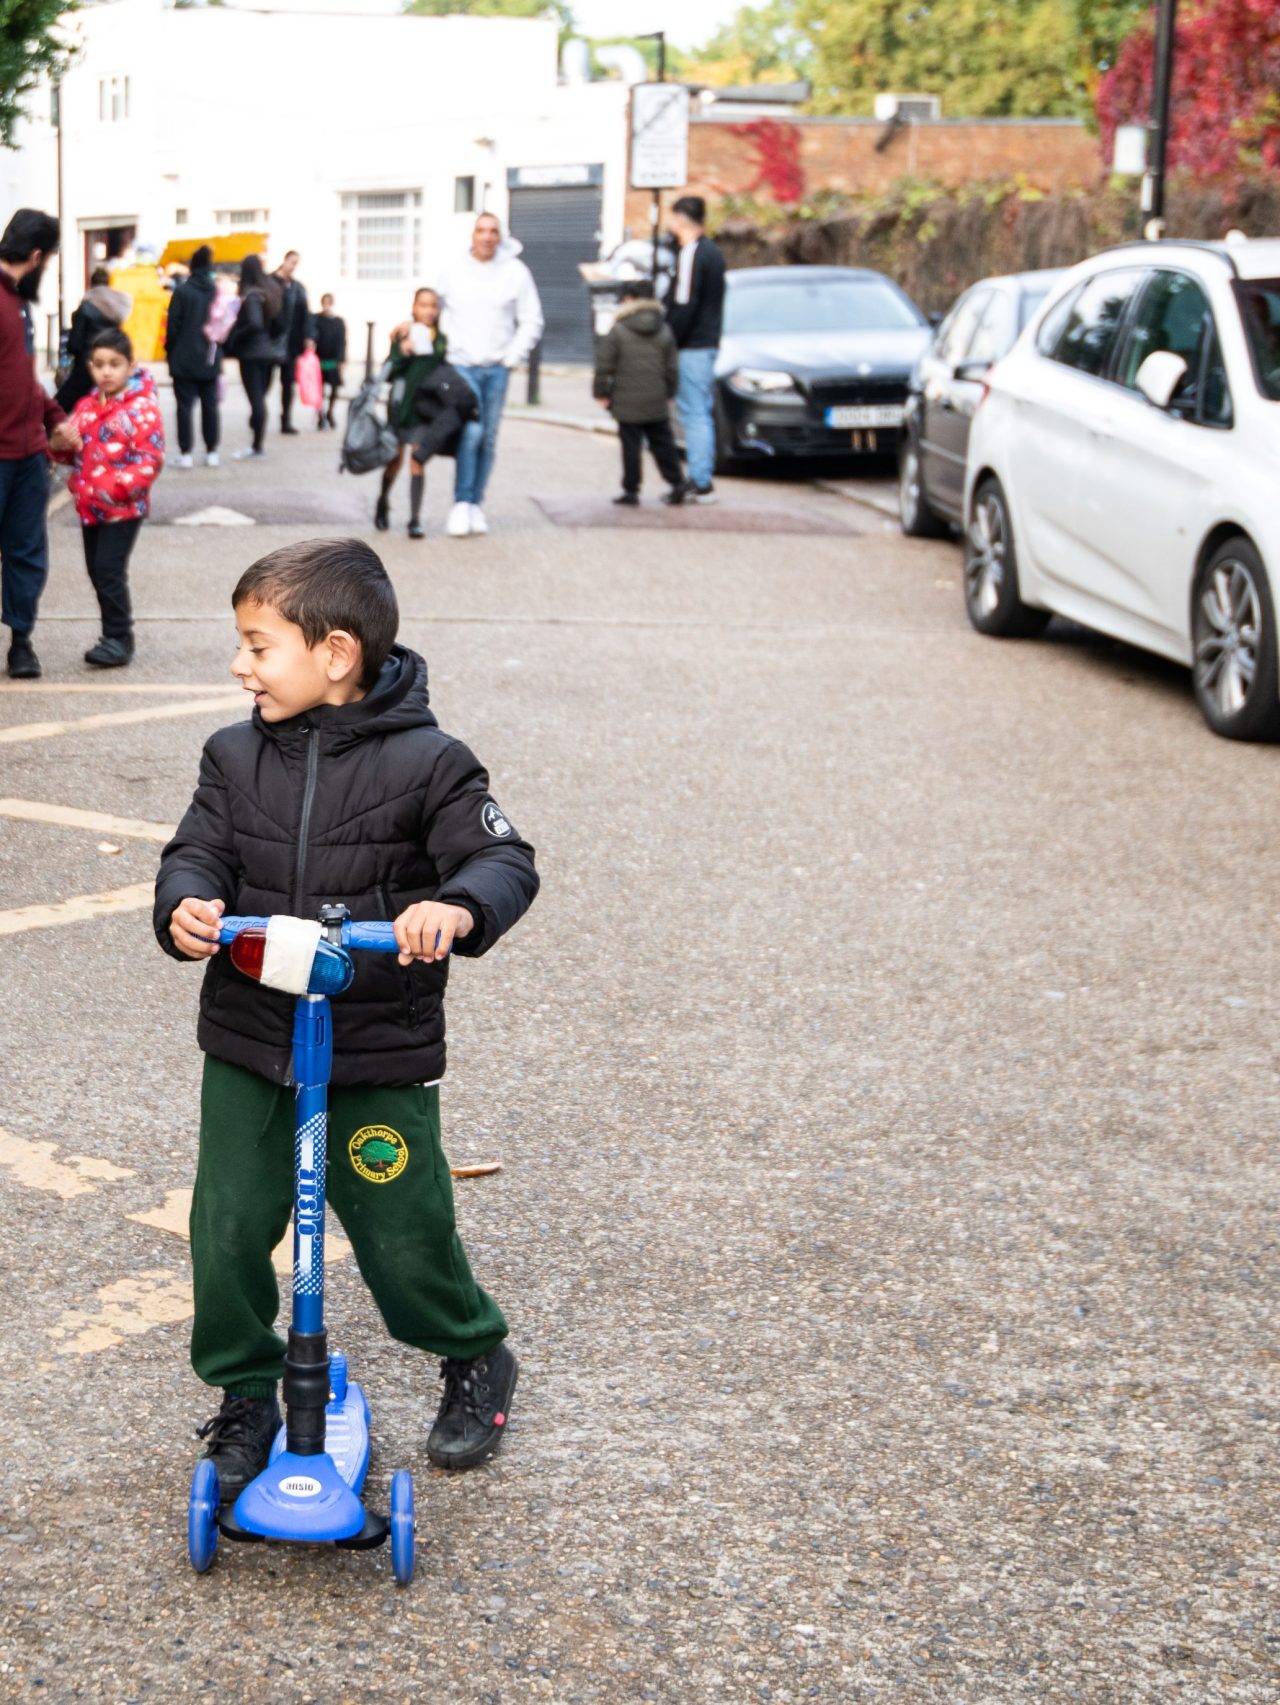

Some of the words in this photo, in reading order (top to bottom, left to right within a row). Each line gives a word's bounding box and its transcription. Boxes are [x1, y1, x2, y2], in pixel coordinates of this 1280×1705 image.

[352, 1128, 397, 1149] Oakthorpe
[352, 1154, 386, 1180] Primary
[386, 1148, 405, 1176] School
[297, 1168, 323, 1236] ansio
[285, 1482, 314, 1492] ansio
